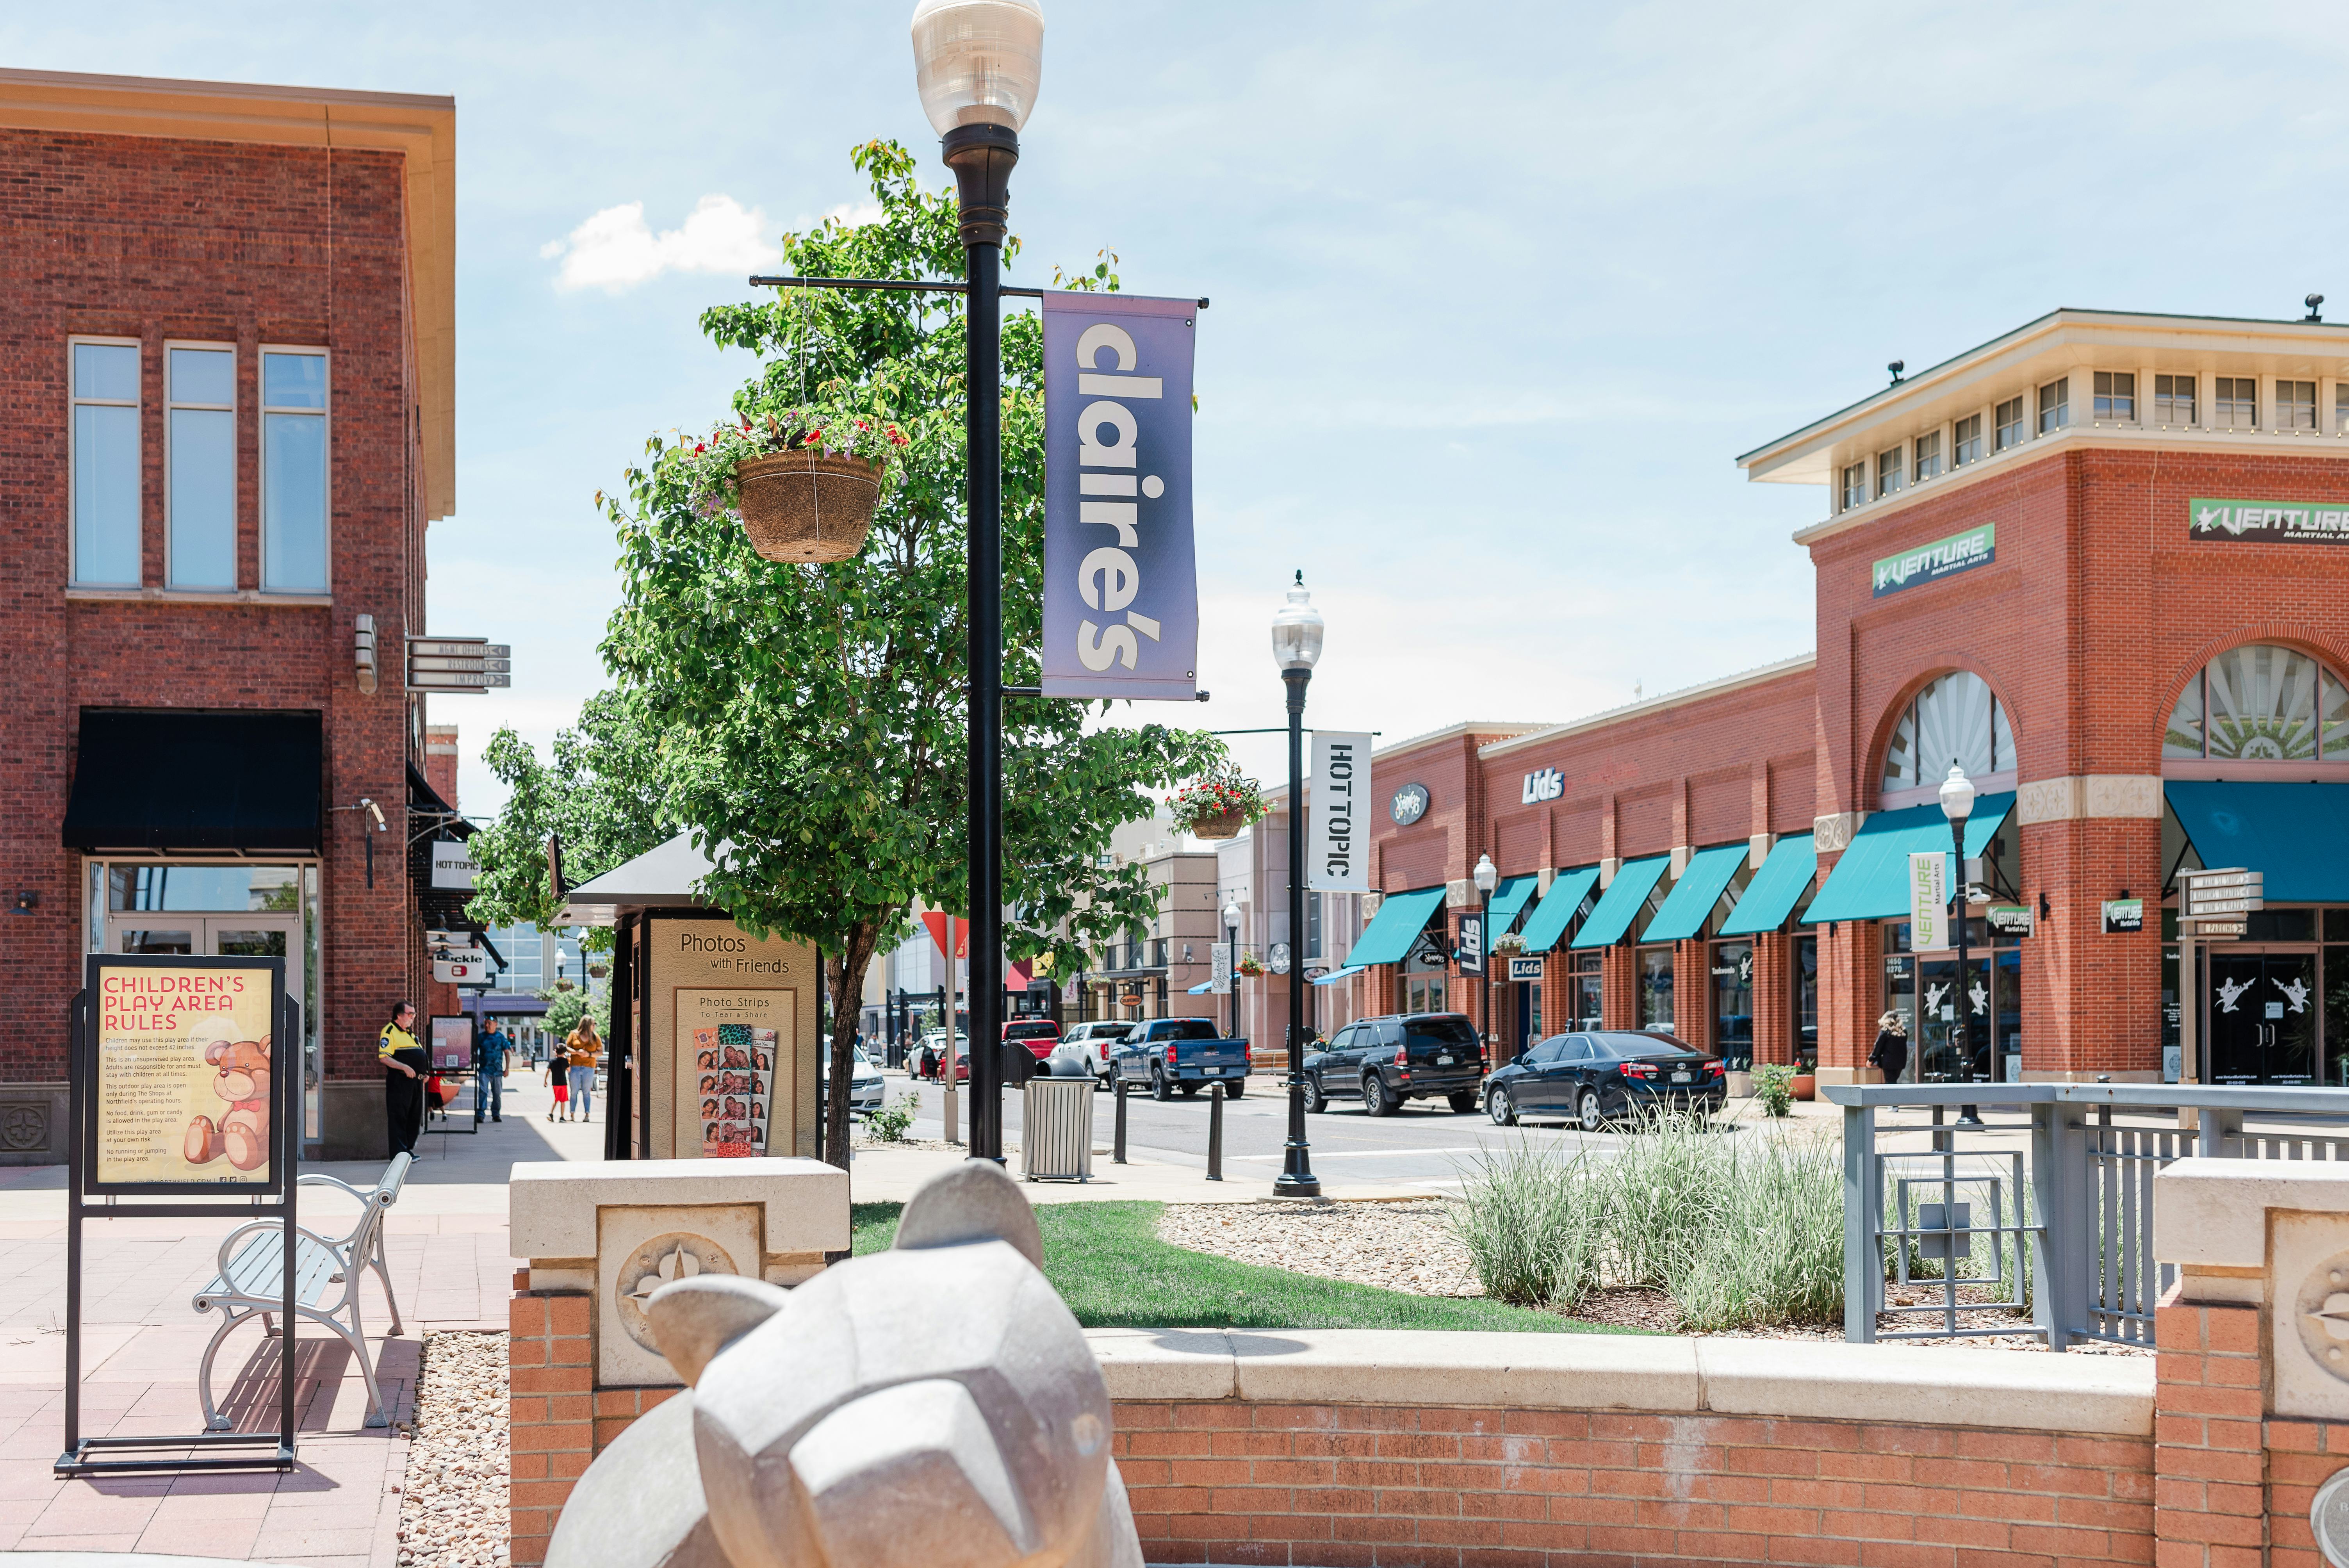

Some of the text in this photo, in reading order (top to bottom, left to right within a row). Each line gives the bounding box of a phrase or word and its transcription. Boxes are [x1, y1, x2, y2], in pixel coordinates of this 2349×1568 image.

[1076, 323, 1165, 671] claire's
[1891, 533, 1985, 585] VENTURE
[1931, 552, 1989, 576] MARTIAL ARTS
[439, 645, 490, 655] MGMT OFFICES
[448, 659, 490, 670] RESTROOMS
[455, 674, 491, 684] IMPROV
[1522, 768, 1564, 804] Lids
[1327, 744, 1353, 877] HOT TOPIC
[435, 860, 478, 870] HOT TOPIC
[1917, 859, 1933, 945] VENTURE
[1993, 912, 2030, 929] VENTURE
[2110, 905, 2142, 924] VENTURE
[2210, 923, 2234, 934] PARKING
[681, 933, 746, 952] Photos
[1460, 919, 1482, 972] Lids
[710, 958, 789, 973] with Friends
[1513, 962, 1541, 975] Lids
[104, 976, 244, 992] CHILDREN'S
[105, 995, 232, 1011] PLAY AREA
[700, 998, 770, 1008] Photo Strips
[105, 1014, 176, 1030] RULES
